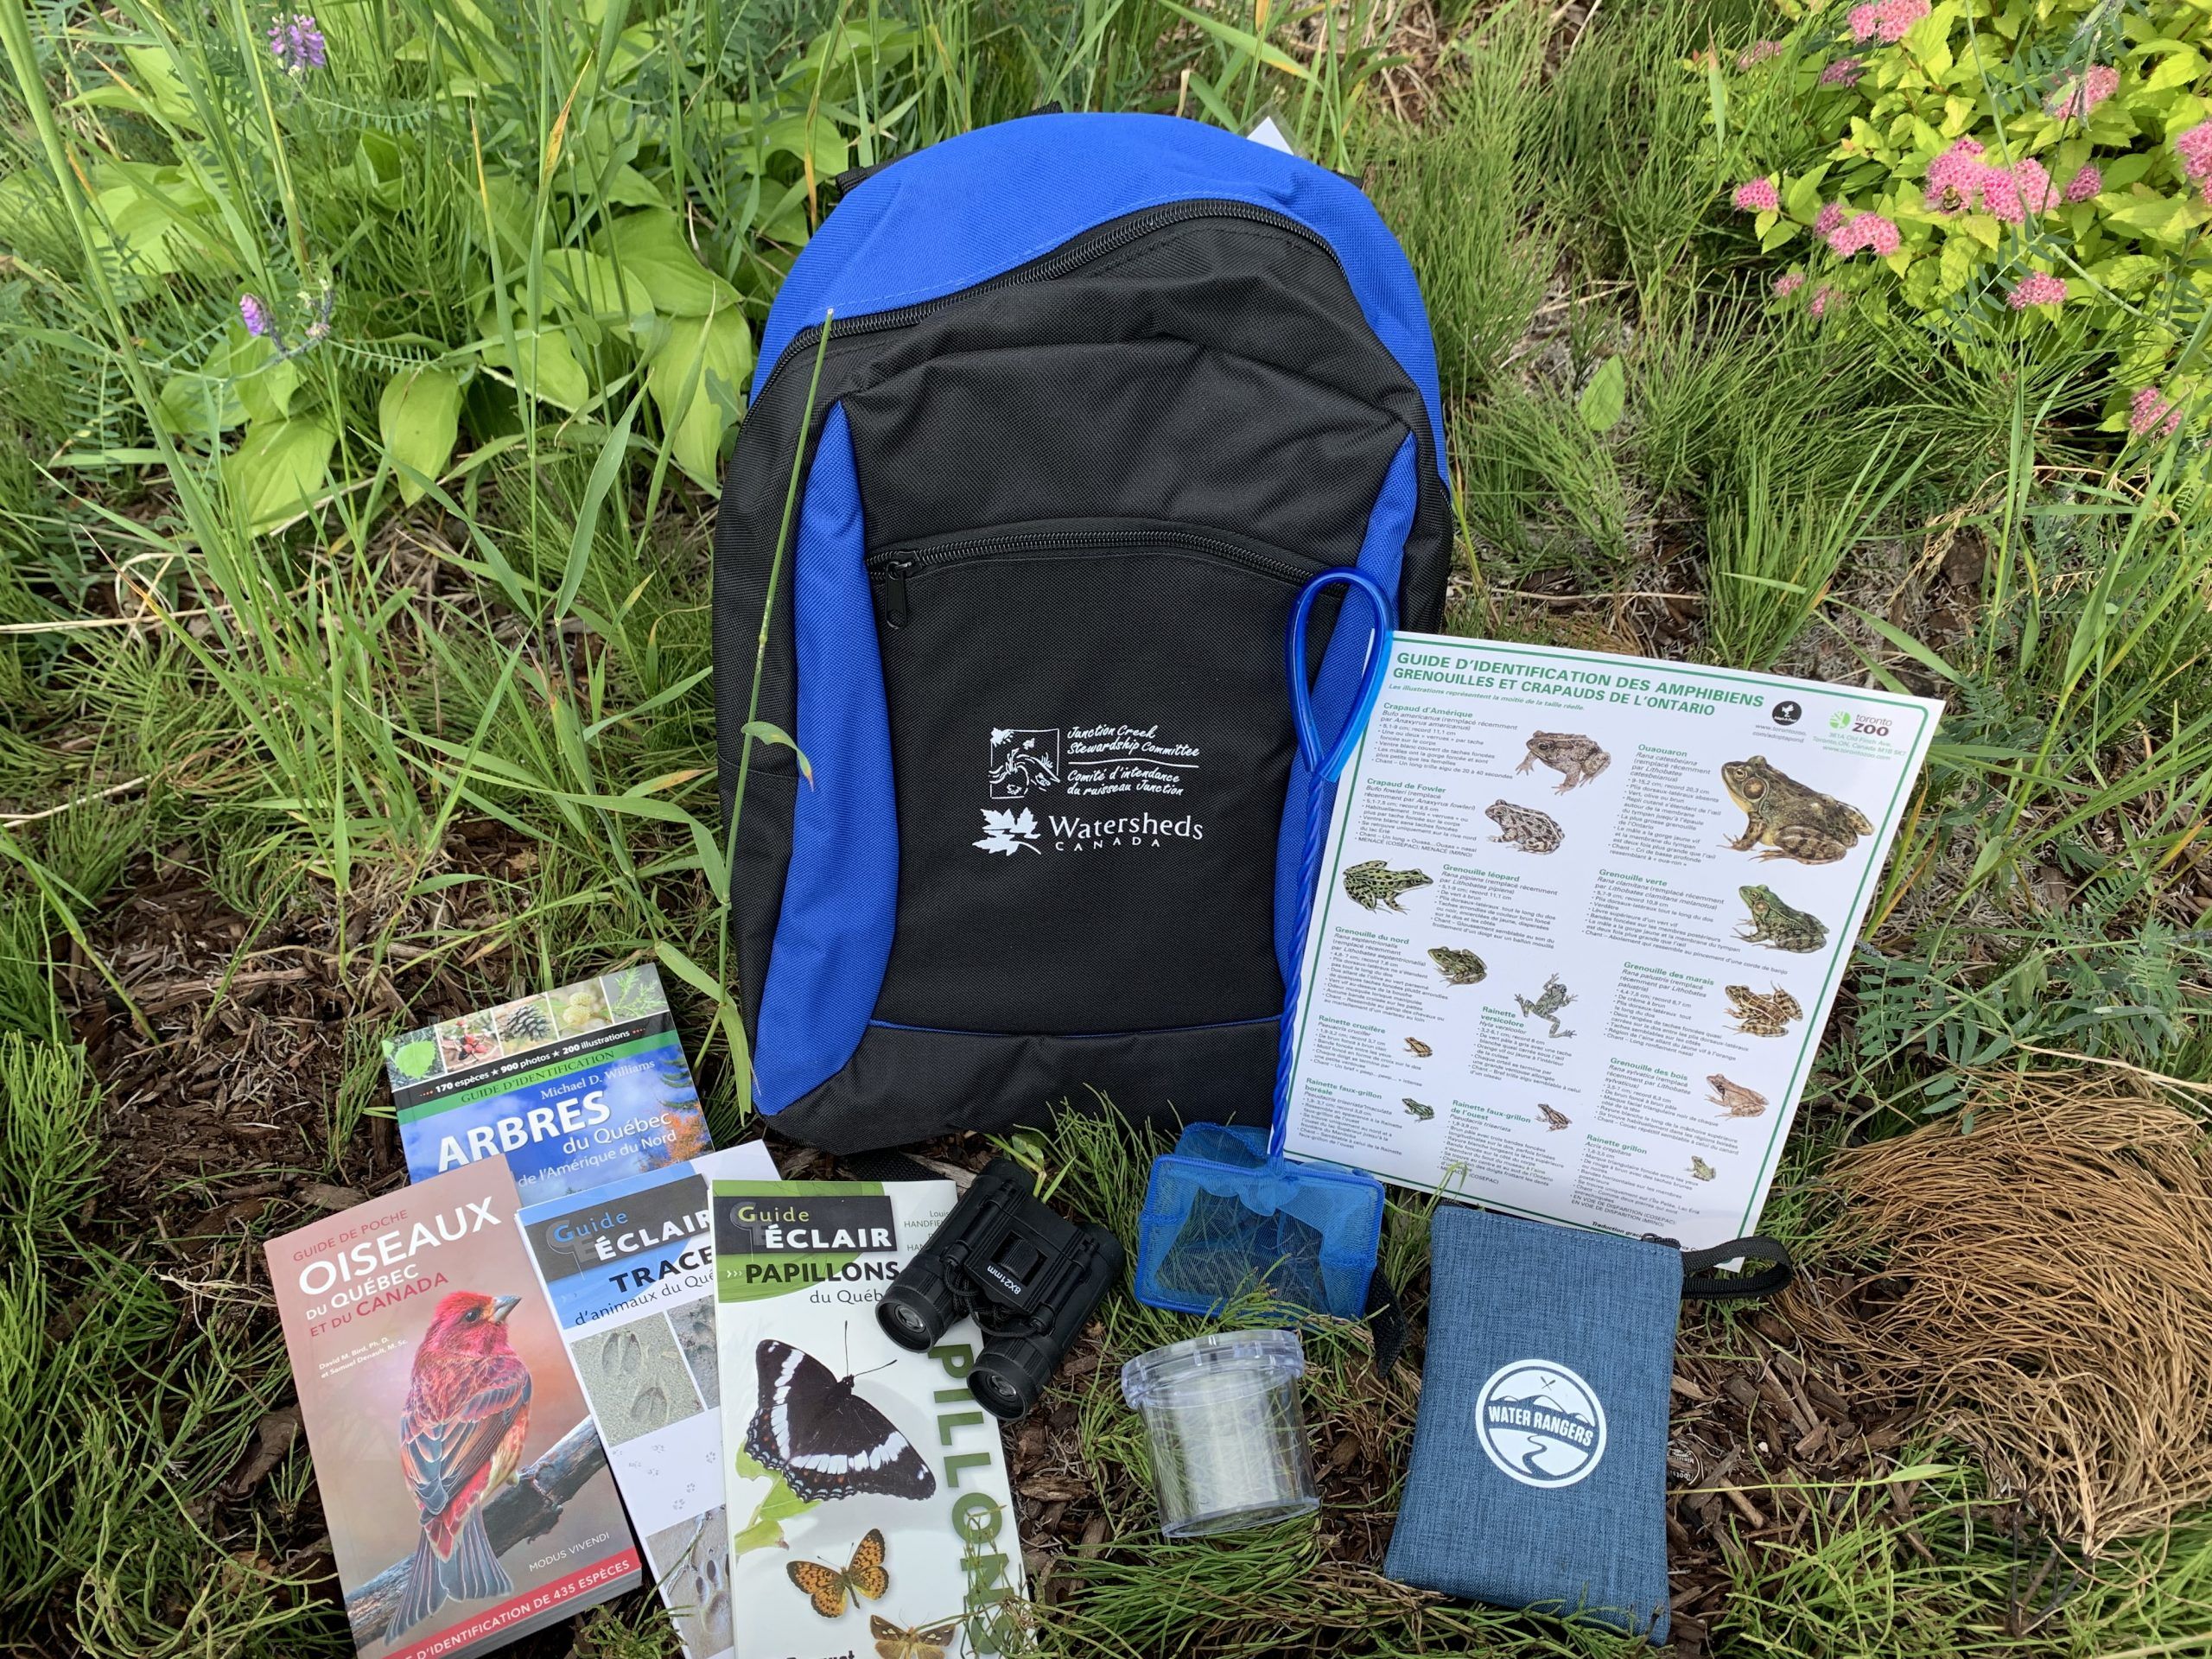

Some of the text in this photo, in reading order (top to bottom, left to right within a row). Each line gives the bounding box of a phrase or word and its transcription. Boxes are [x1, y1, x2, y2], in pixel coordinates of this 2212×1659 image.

[1396, 652, 1764, 707] GUIDE D'IDENTIFICATION DES AMPHIBIENS
[1393, 667, 1715, 716] GRENOUILLES ET CRAPAUDS DE L'ONTARIO
[1402, 684, 1445, 694] illustrations
[1446, 690, 1491, 701] représentent
[1501, 695, 1524, 704] moitié
[1384, 702, 1472, 719] Crapaud d'Amérique
[1856, 715, 1892, 727] toronto
[1067, 724, 1158, 740] Junction Creek
[1853, 722, 1889, 736] ZOO
[1067, 738, 1199, 757] Stewardship Committee
[1638, 744, 1688, 757] Ouaouaron
[1067, 766, 1180, 783] Comité d'intendance
[1367, 778, 1402, 788] Crapaud
[1417, 784, 1446, 793] Fowler
[1067, 781, 1184, 796] du ruisseau Junction
[1049, 812, 1203, 840] Watersheds
[1056, 836, 1160, 852] CANADA
[1443, 864, 1520, 882] Grenouille léopard
[1599, 868, 1667, 887] Grenouille verte
[1335, 926, 1376, 938] Grenouille
[1624, 961, 1714, 985] Grenouille des marais
[1481, 1014, 1524, 1028] versicolore
[1483, 1006, 1516, 1018] Rainette
[1319, 1015, 1385, 1033] Rainette crucifère
[435, 1029, 630, 1093] 170 espèces 900 photos 200 illustrations
[1611, 1057, 1652, 1072] Grenouille
[1670, 1072, 1688, 1081] bois
[461, 1050, 614, 1103] GUIDE D'IDENTIFICATION
[541, 1058, 656, 1101] Michael D. Williams
[1305, 1084, 1332, 1096] boréale
[1306, 1077, 1382, 1099] Rainette faux-grillon
[1452, 1099, 1531, 1123] Rainette faux-grillon
[1462, 1109, 1488, 1121] l'ouest
[438, 1090, 611, 1173] ARBRES
[563, 1111, 672, 1155] du Québec
[1586, 1135, 1647, 1154] Rainette grillon
[518, 1130, 677, 1189] de l'Amérique du Nord
[738, 1205, 810, 1223] Guide
[294, 1210, 408, 1262] GUIDE DE POCHE
[553, 1212, 628, 1243] Guide
[766, 1224, 892, 1249] ÉCLAIR
[1592, 1221, 1624, 1234] Traduction
[299, 1196, 501, 1295] OISEAUX
[746, 1262, 899, 1284] PAPILLONS
[306, 1263, 419, 1320] DU QUÉBEC
[810, 1291, 831, 1304] du
[311, 1272, 448, 1338] ET DU CANADA
[575, 1292, 658, 1325] d'animaux
[662, 1282, 682, 1297] du
[1488, 1406, 1593, 1446] WATER RANGERS
[529, 1531, 610, 1573] MODUS VIVENDI
[416, 1559, 630, 1659] D'IDENTIFICATION DE 435 ESPÈCES
